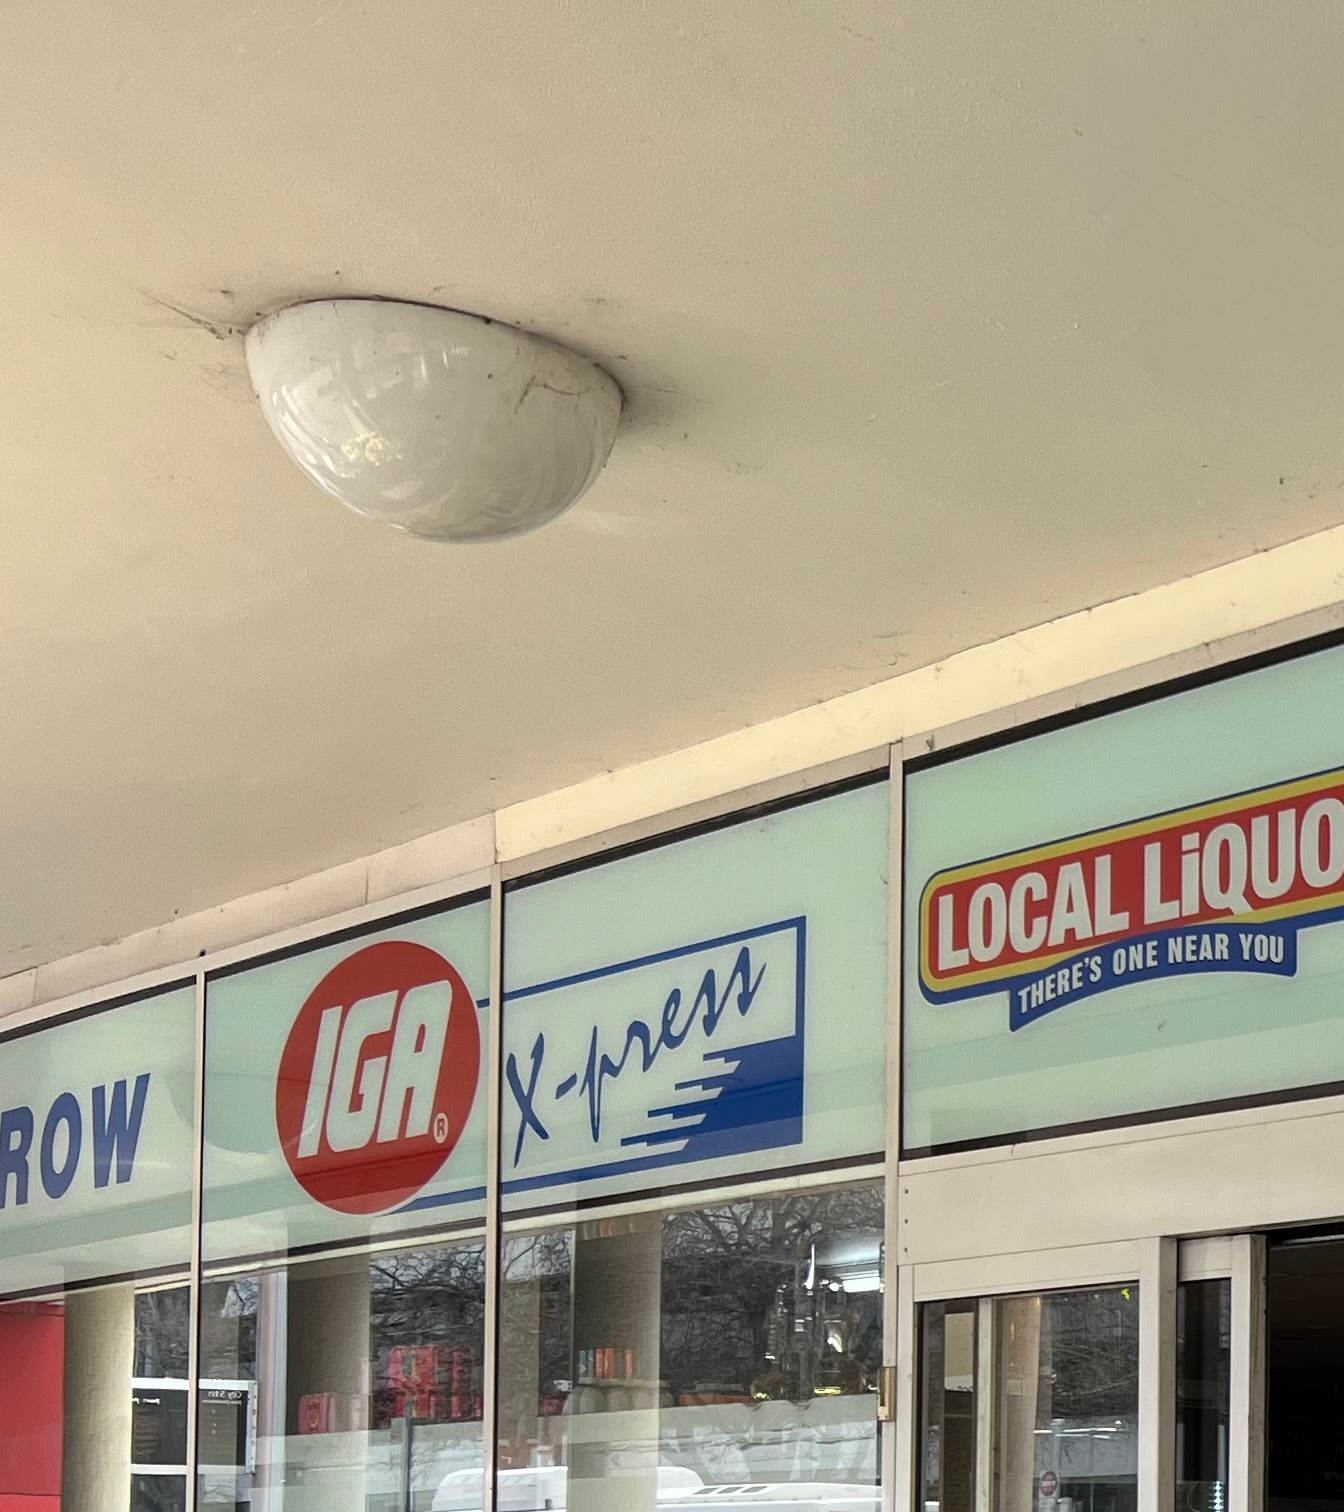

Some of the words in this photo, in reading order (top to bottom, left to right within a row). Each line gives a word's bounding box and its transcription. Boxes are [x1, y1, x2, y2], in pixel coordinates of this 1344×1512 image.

[936, 854, 1130, 972] LOCAL
[1018, 955, 1102, 1016] THERE'S
[1112, 942, 1158, 973] ONE
[1168, 933, 1230, 964] NEAR
[1238, 931, 1286, 962] YOU
[297, 979, 453, 1159] IGA
[505, 945, 767, 1168] X-press
[0, 1073, 151, 1206] ROW
